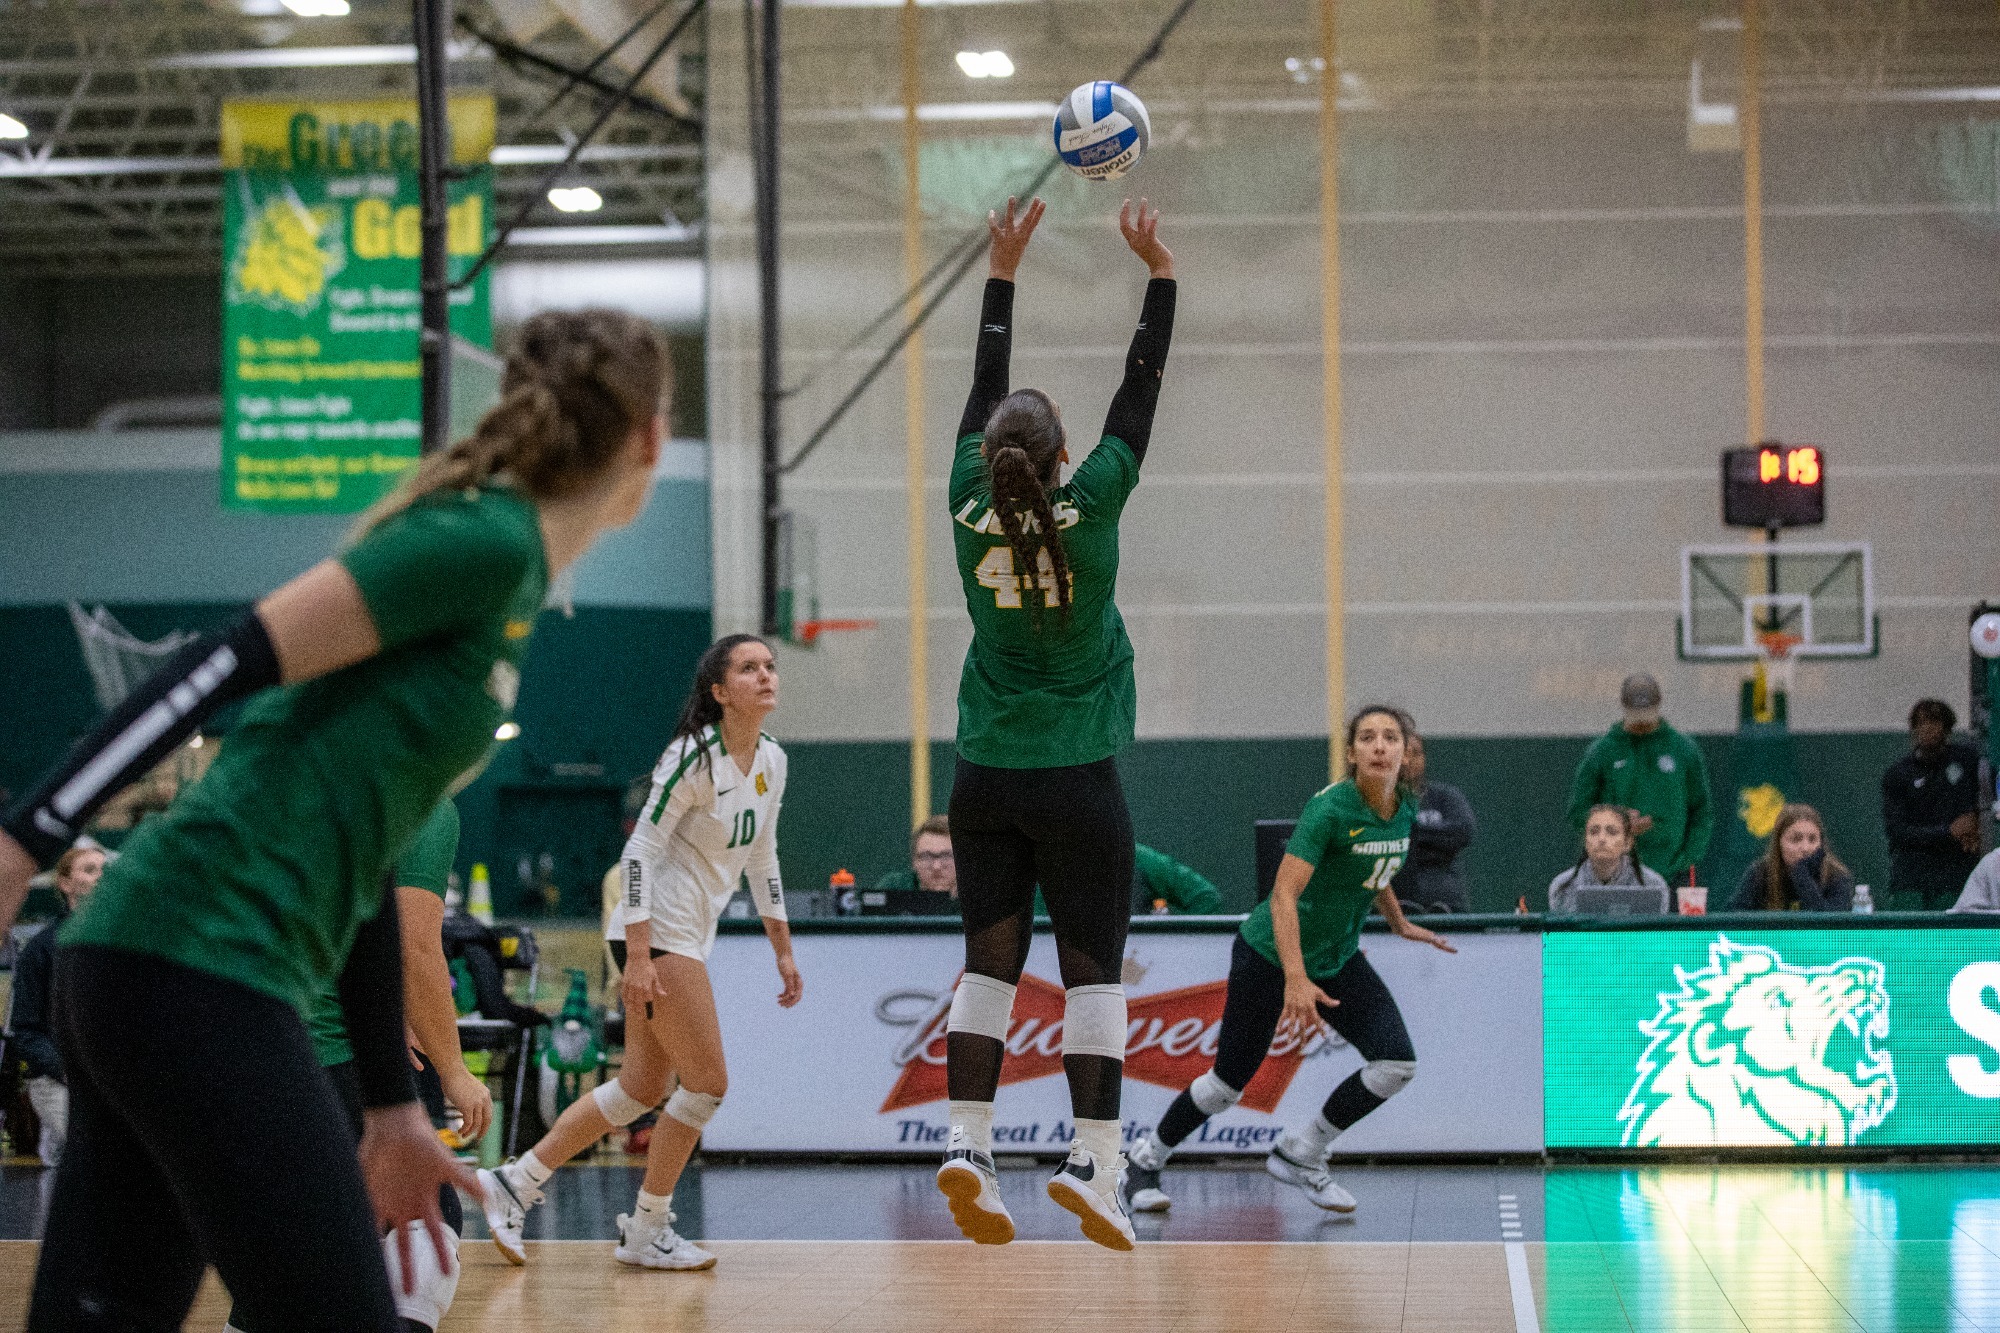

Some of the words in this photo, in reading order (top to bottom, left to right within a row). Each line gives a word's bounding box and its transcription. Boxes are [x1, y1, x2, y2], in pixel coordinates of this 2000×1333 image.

[289, 112, 424, 174] Gree
[1081, 150, 1133, 177] molten
[353, 194, 483, 260] God
[974, 546, 1073, 608] 44
[727, 808, 755, 849] 10
[899, 1119, 949, 1144] The
[1199, 1119, 1284, 1147] Lager
